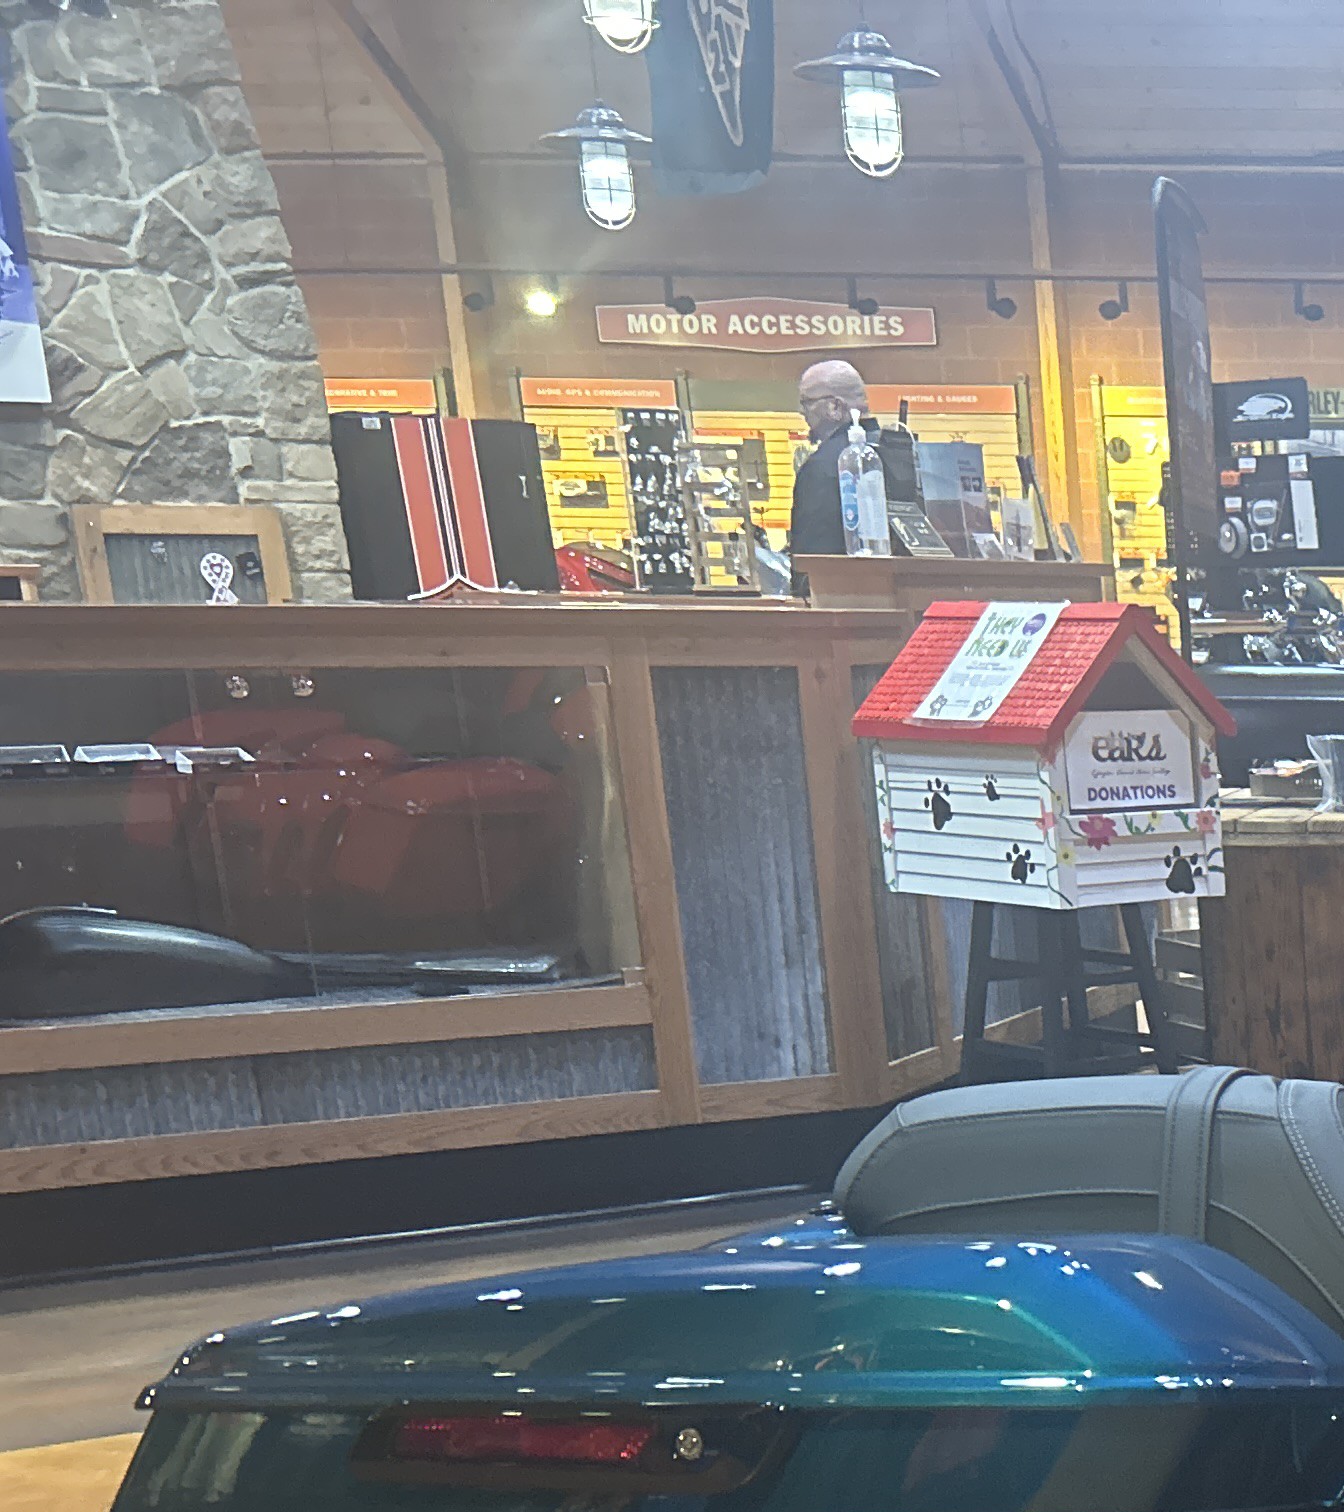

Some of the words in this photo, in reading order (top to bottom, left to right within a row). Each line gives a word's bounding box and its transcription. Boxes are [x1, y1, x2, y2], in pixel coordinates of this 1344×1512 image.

[627, 314, 718, 335] MOTOR
[727, 315, 905, 337] ACCESSORIES
[1087, 784, 1176, 802] DONATIONS
